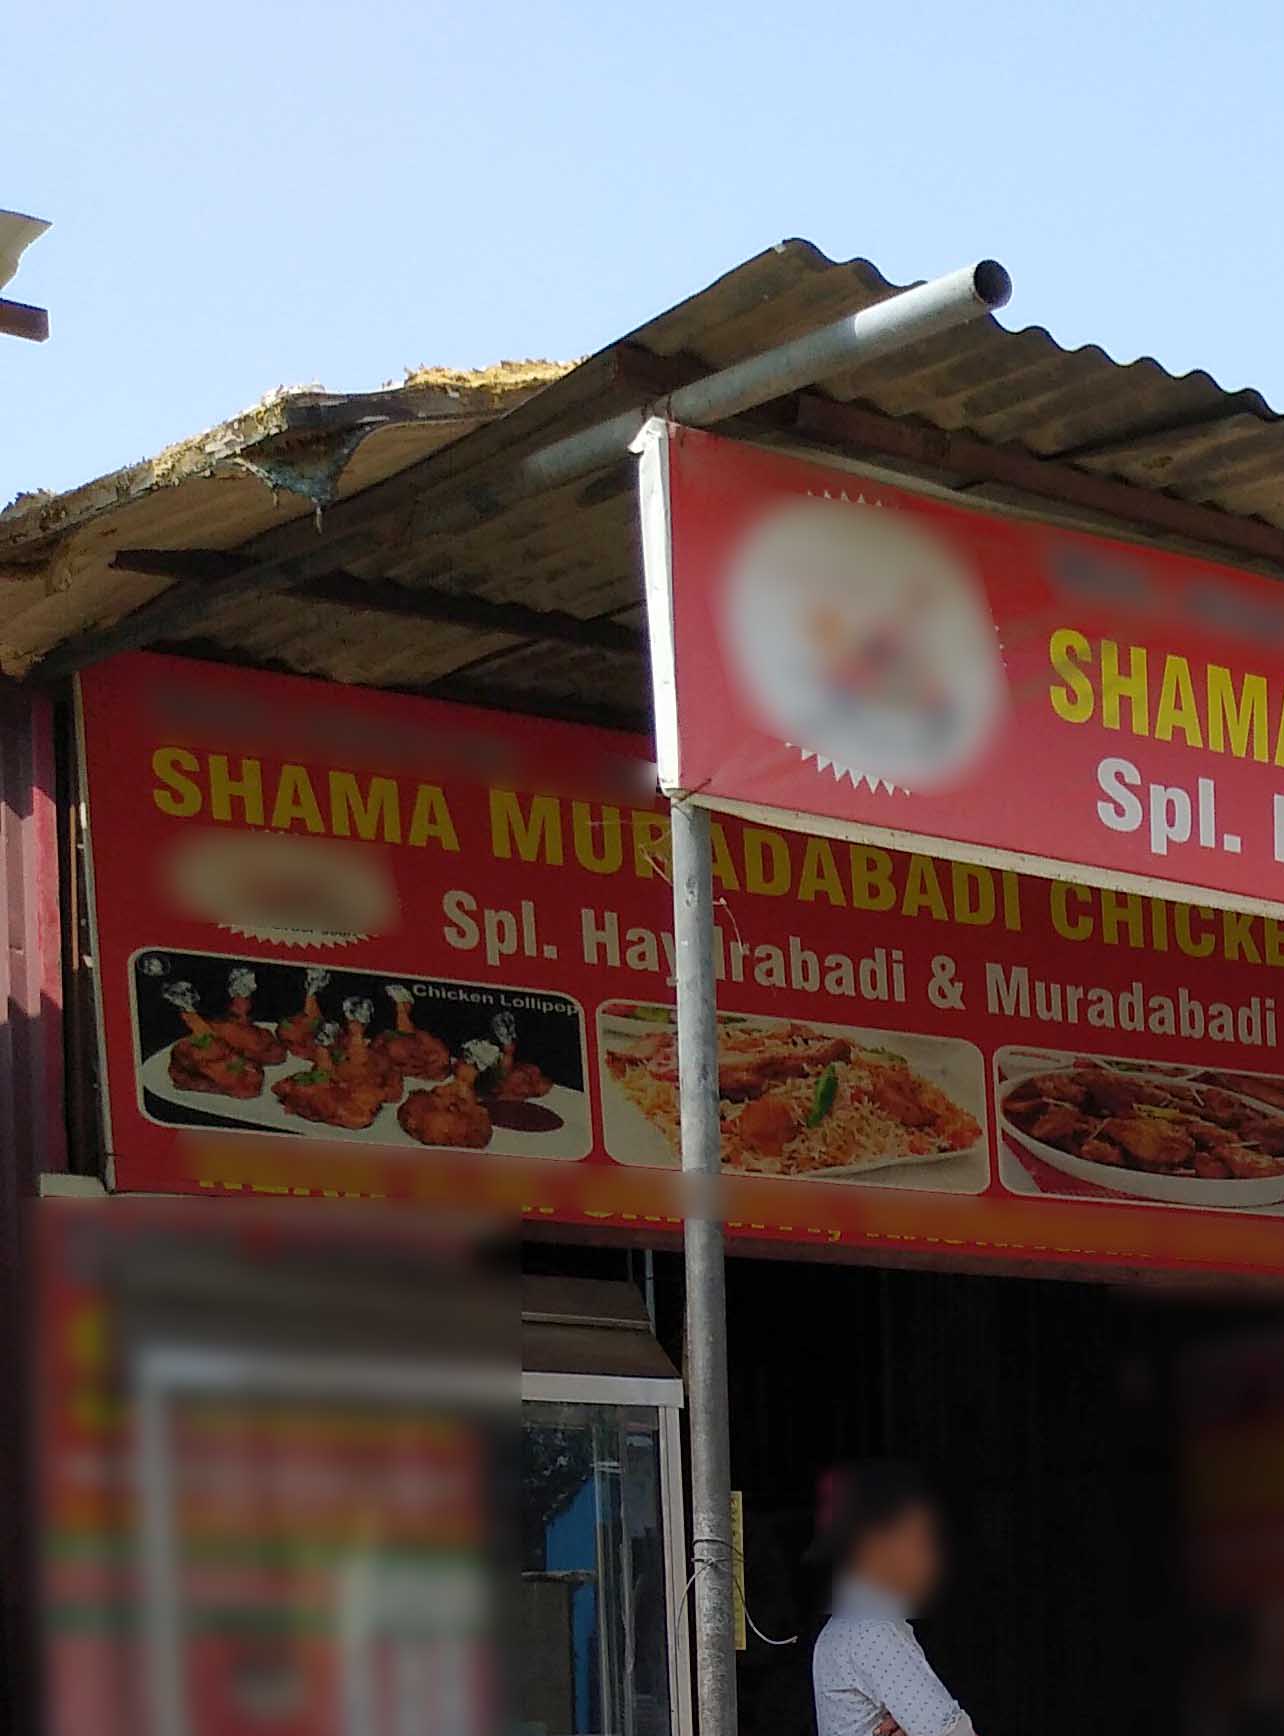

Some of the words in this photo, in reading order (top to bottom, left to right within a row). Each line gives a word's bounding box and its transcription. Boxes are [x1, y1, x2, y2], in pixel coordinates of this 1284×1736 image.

[152, 746, 461, 852] SHAMA
[1096, 756, 1242, 856] Spl.
[412, 983, 494, 1006] Chicken
[499, 992, 578, 1016] Lollipop
[442, 889, 558, 967] Spl.
[927, 954, 965, 1009] &
[985, 962, 1277, 1048] Muradabadi
